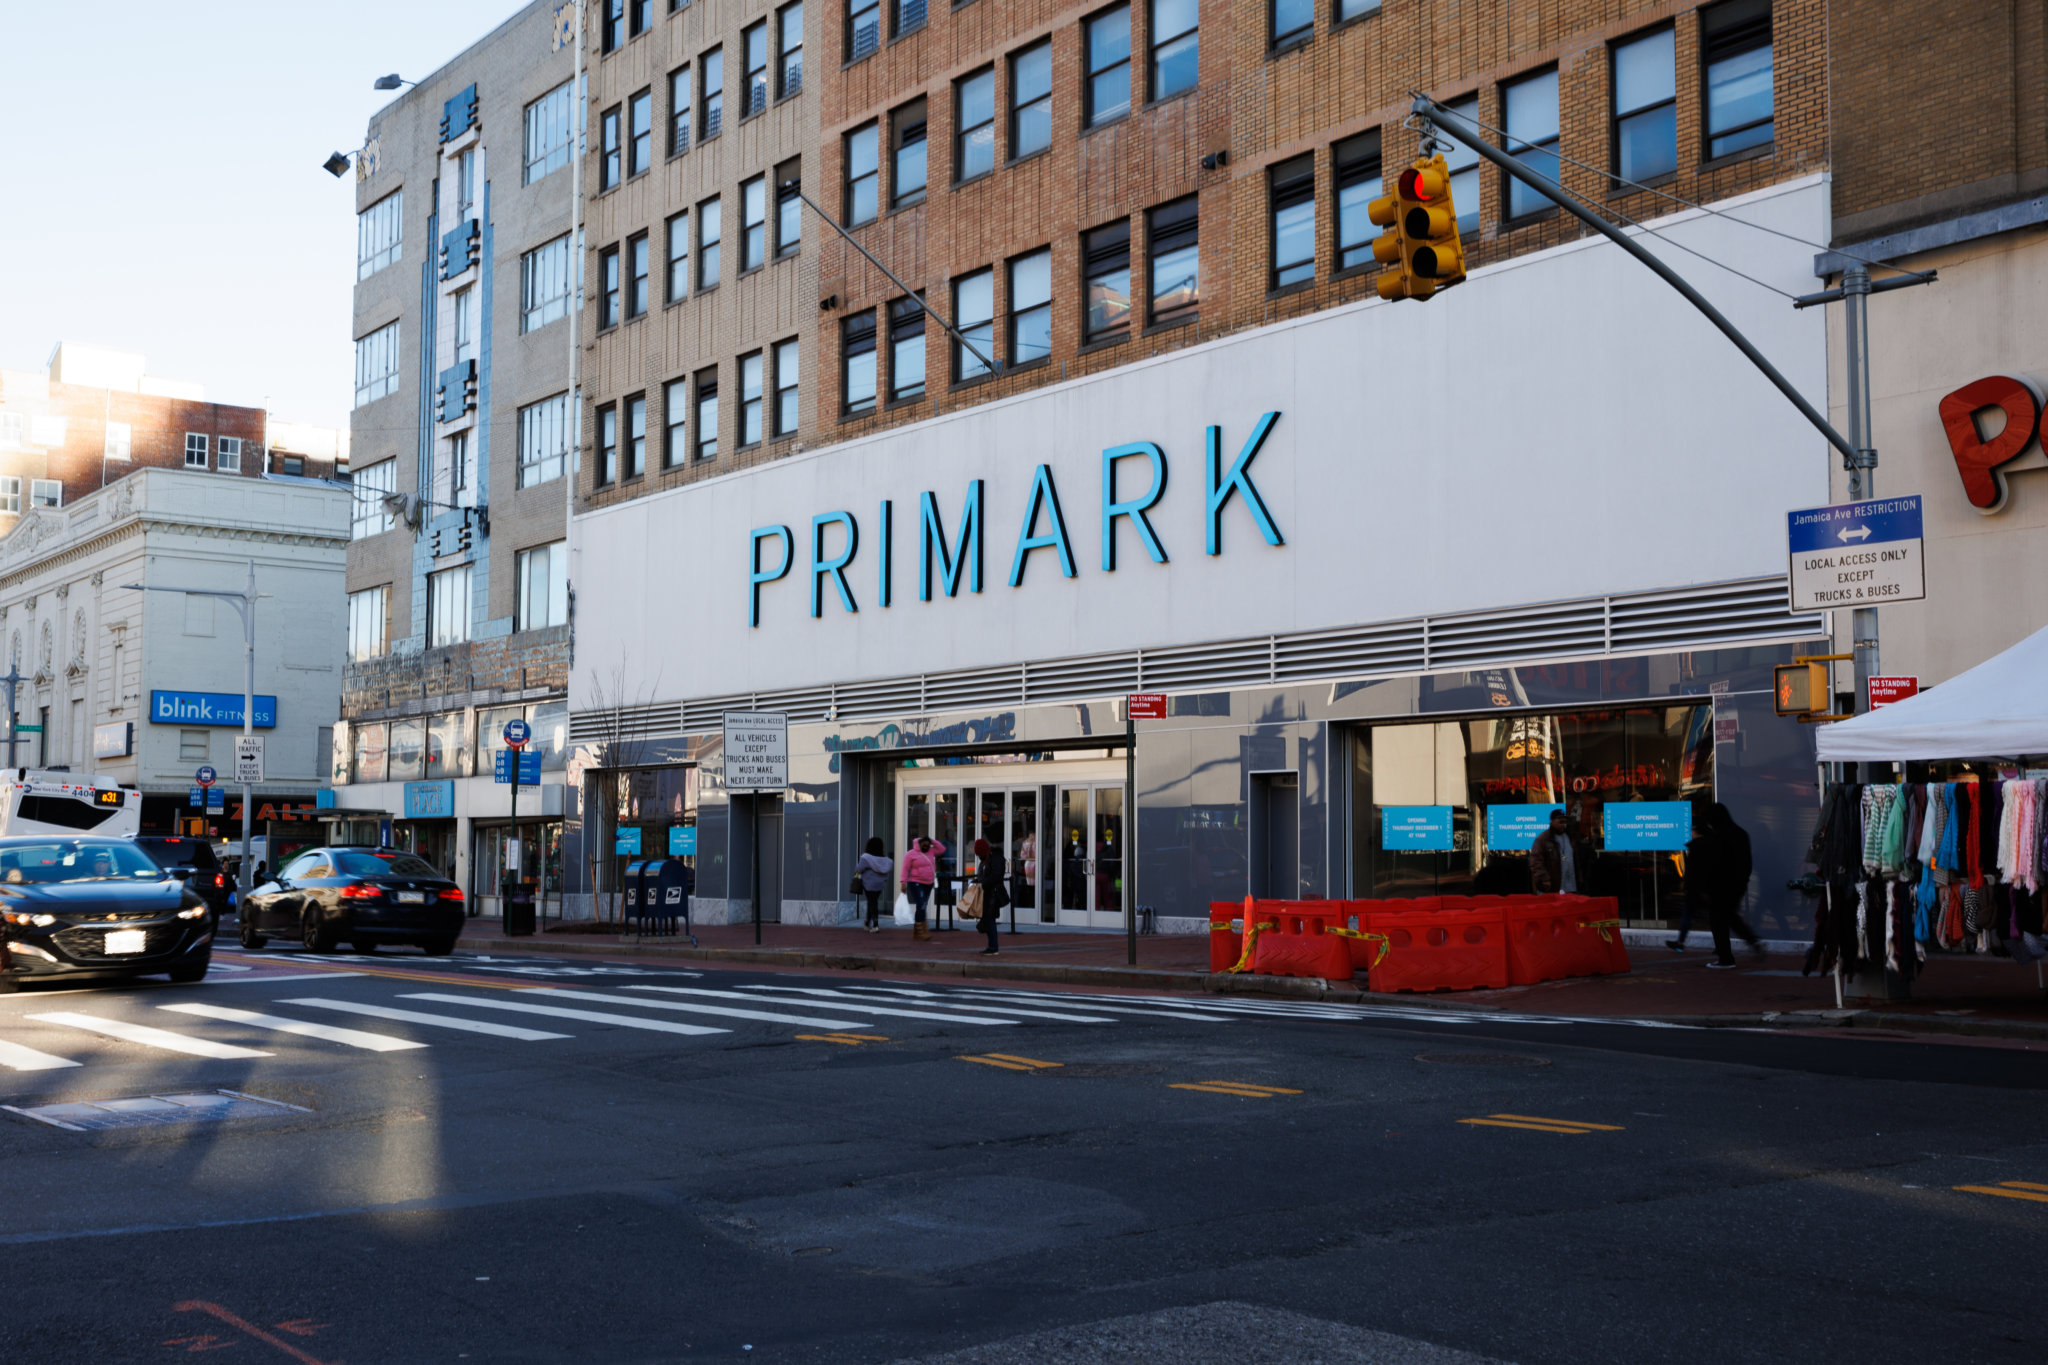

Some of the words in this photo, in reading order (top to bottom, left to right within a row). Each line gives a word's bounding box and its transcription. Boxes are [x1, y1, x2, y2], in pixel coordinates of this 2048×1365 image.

[1939, 375, 2048, 508] P
[749, 411, 1286, 628] PRIMARK
[1794, 512, 1831, 525] Jamaica
[1835, 510, 1851, 520] Ave
[1855, 499, 1916, 517] RESTRICTION
[1805, 558, 1836, 571] LOCAL
[1839, 553, 1877, 566] ACCESS
[1881, 549, 1907, 562] ONLY
[1838, 570, 1874, 583] EXCEPT
[1814, 589, 1851, 602] TRUCKS
[1855, 588, 1864, 598] &
[1868, 584, 1900, 597] BUSES
[1872, 688, 1897, 696] Anytime
[159, 696, 213, 719] blink
[216, 710, 269, 721] FITNSS
[734, 734, 746, 742] ALL
[748, 734, 777, 742] VEHICLES
[726, 755, 750, 763] TRUCKS
[751, 755, 764, 763] AND
[765, 755, 786, 763] BUSES
[739, 766, 755, 774] MUST
[757, 766, 774, 774] MAKE
[72, 789, 94, 798] 4404
[412, 793, 443, 814] PLACE
